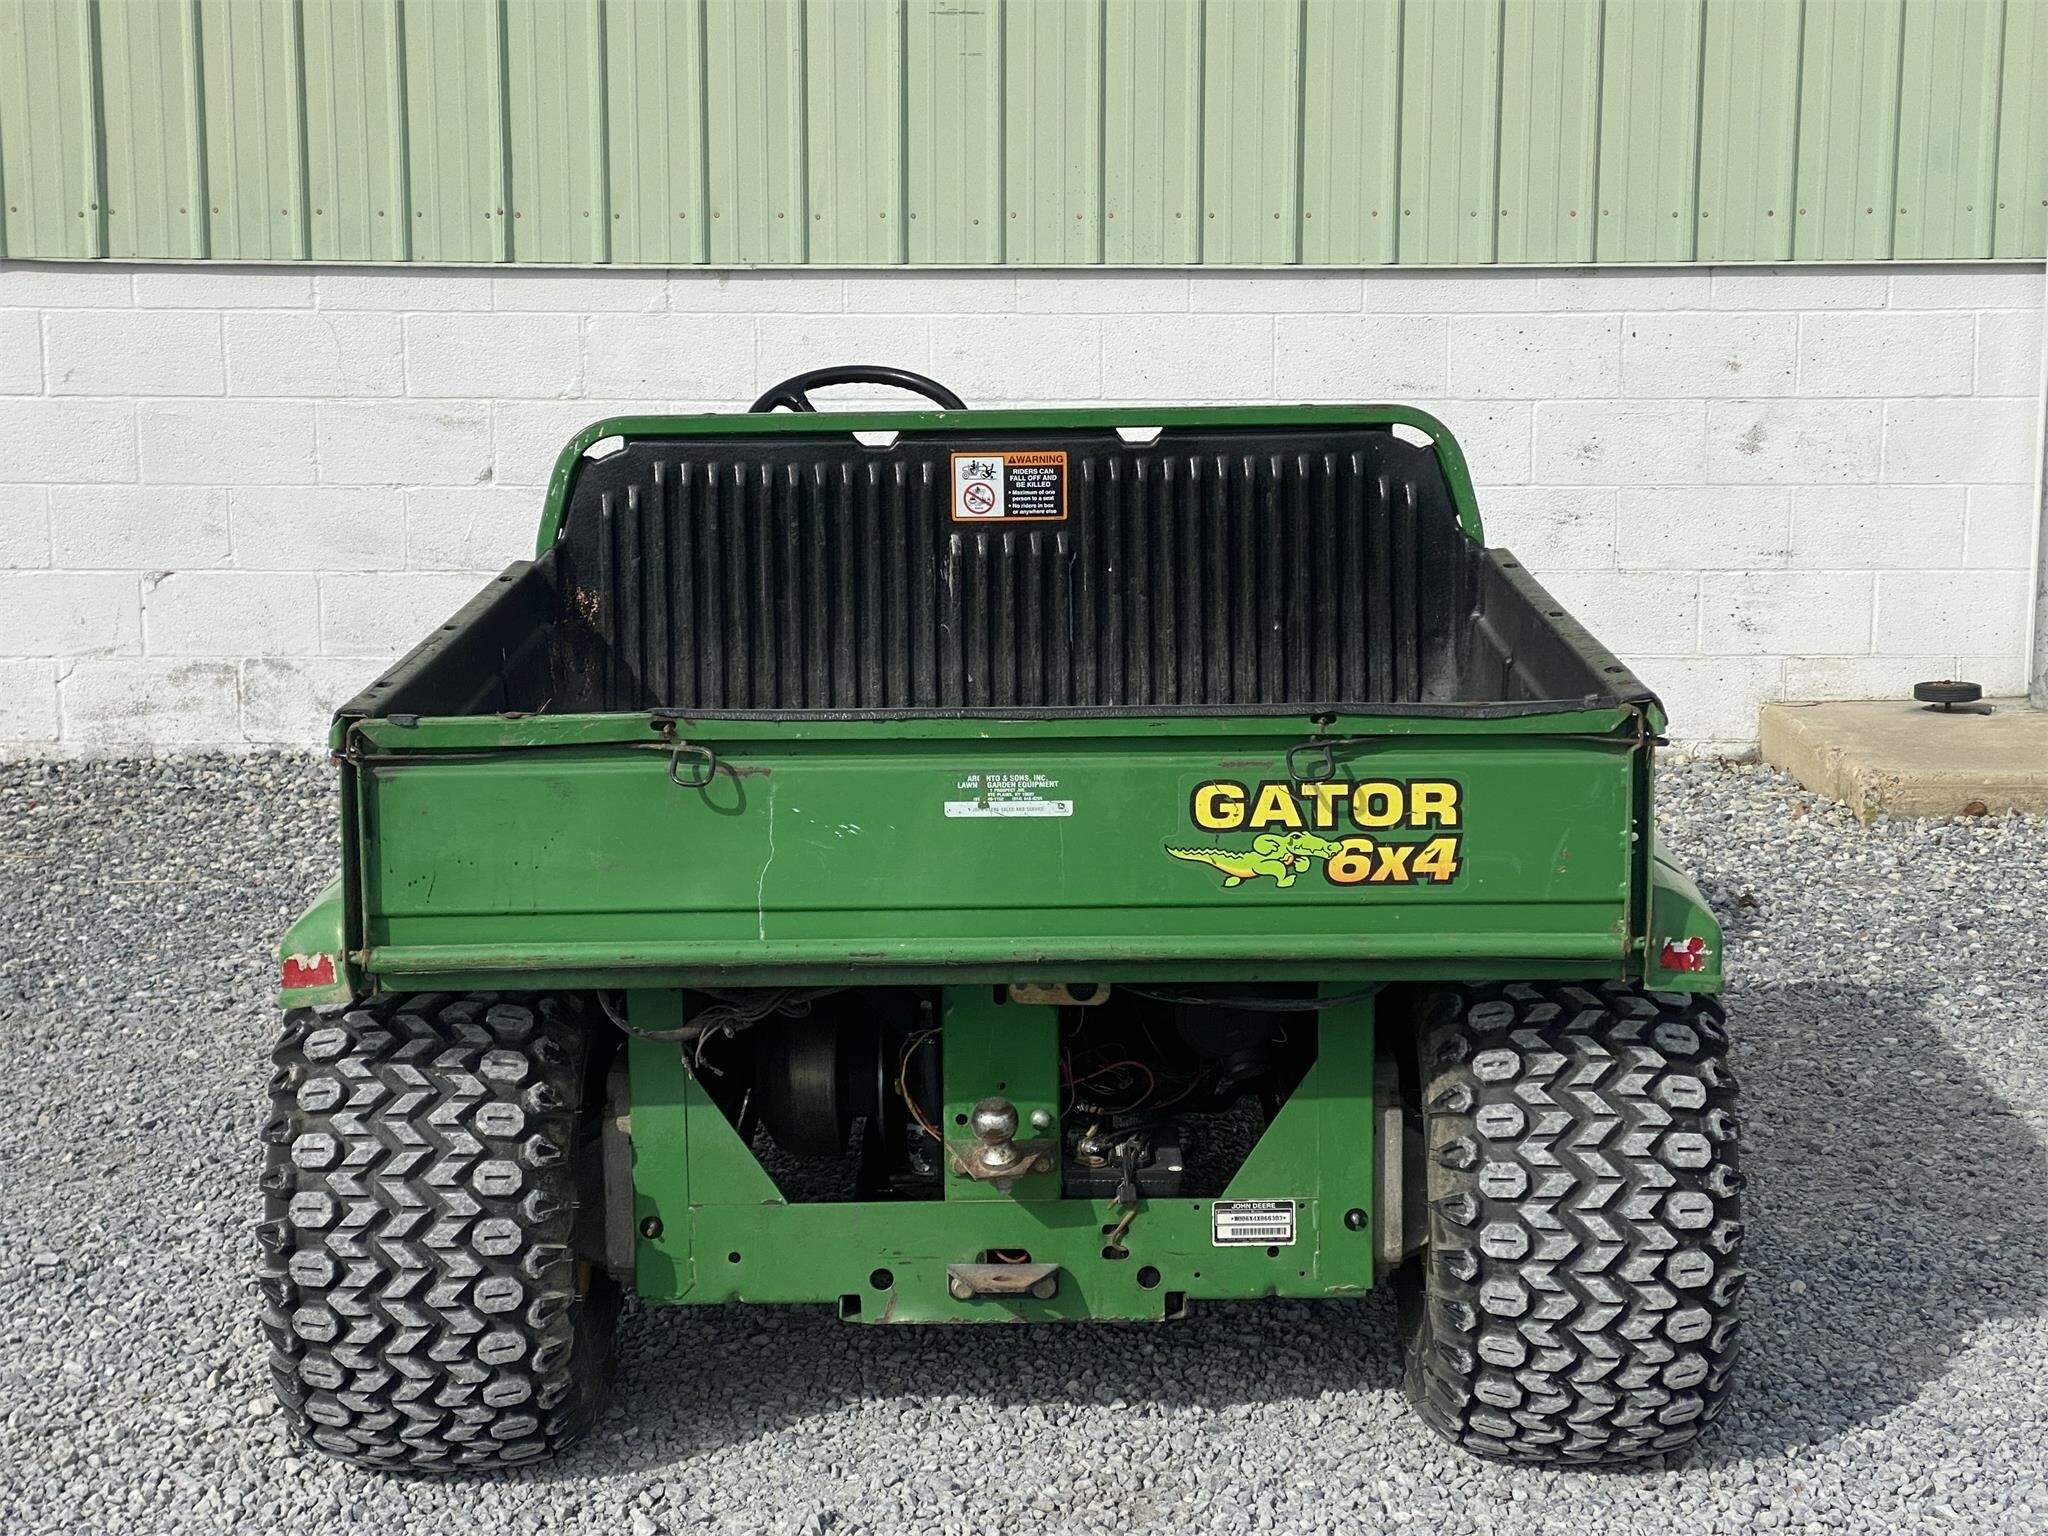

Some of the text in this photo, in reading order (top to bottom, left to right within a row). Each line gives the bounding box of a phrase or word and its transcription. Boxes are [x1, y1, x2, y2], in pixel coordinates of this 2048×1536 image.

[1016, 455, 1063, 463] WARNING
[1009, 774, 1032, 782] SONS,
[986, 781, 1016, 789] GARDEN
[1017, 780, 1059, 788] EQUIPMENT
[1192, 780, 1460, 831] GATOR
[1327, 836, 1459, 884] 6x4
